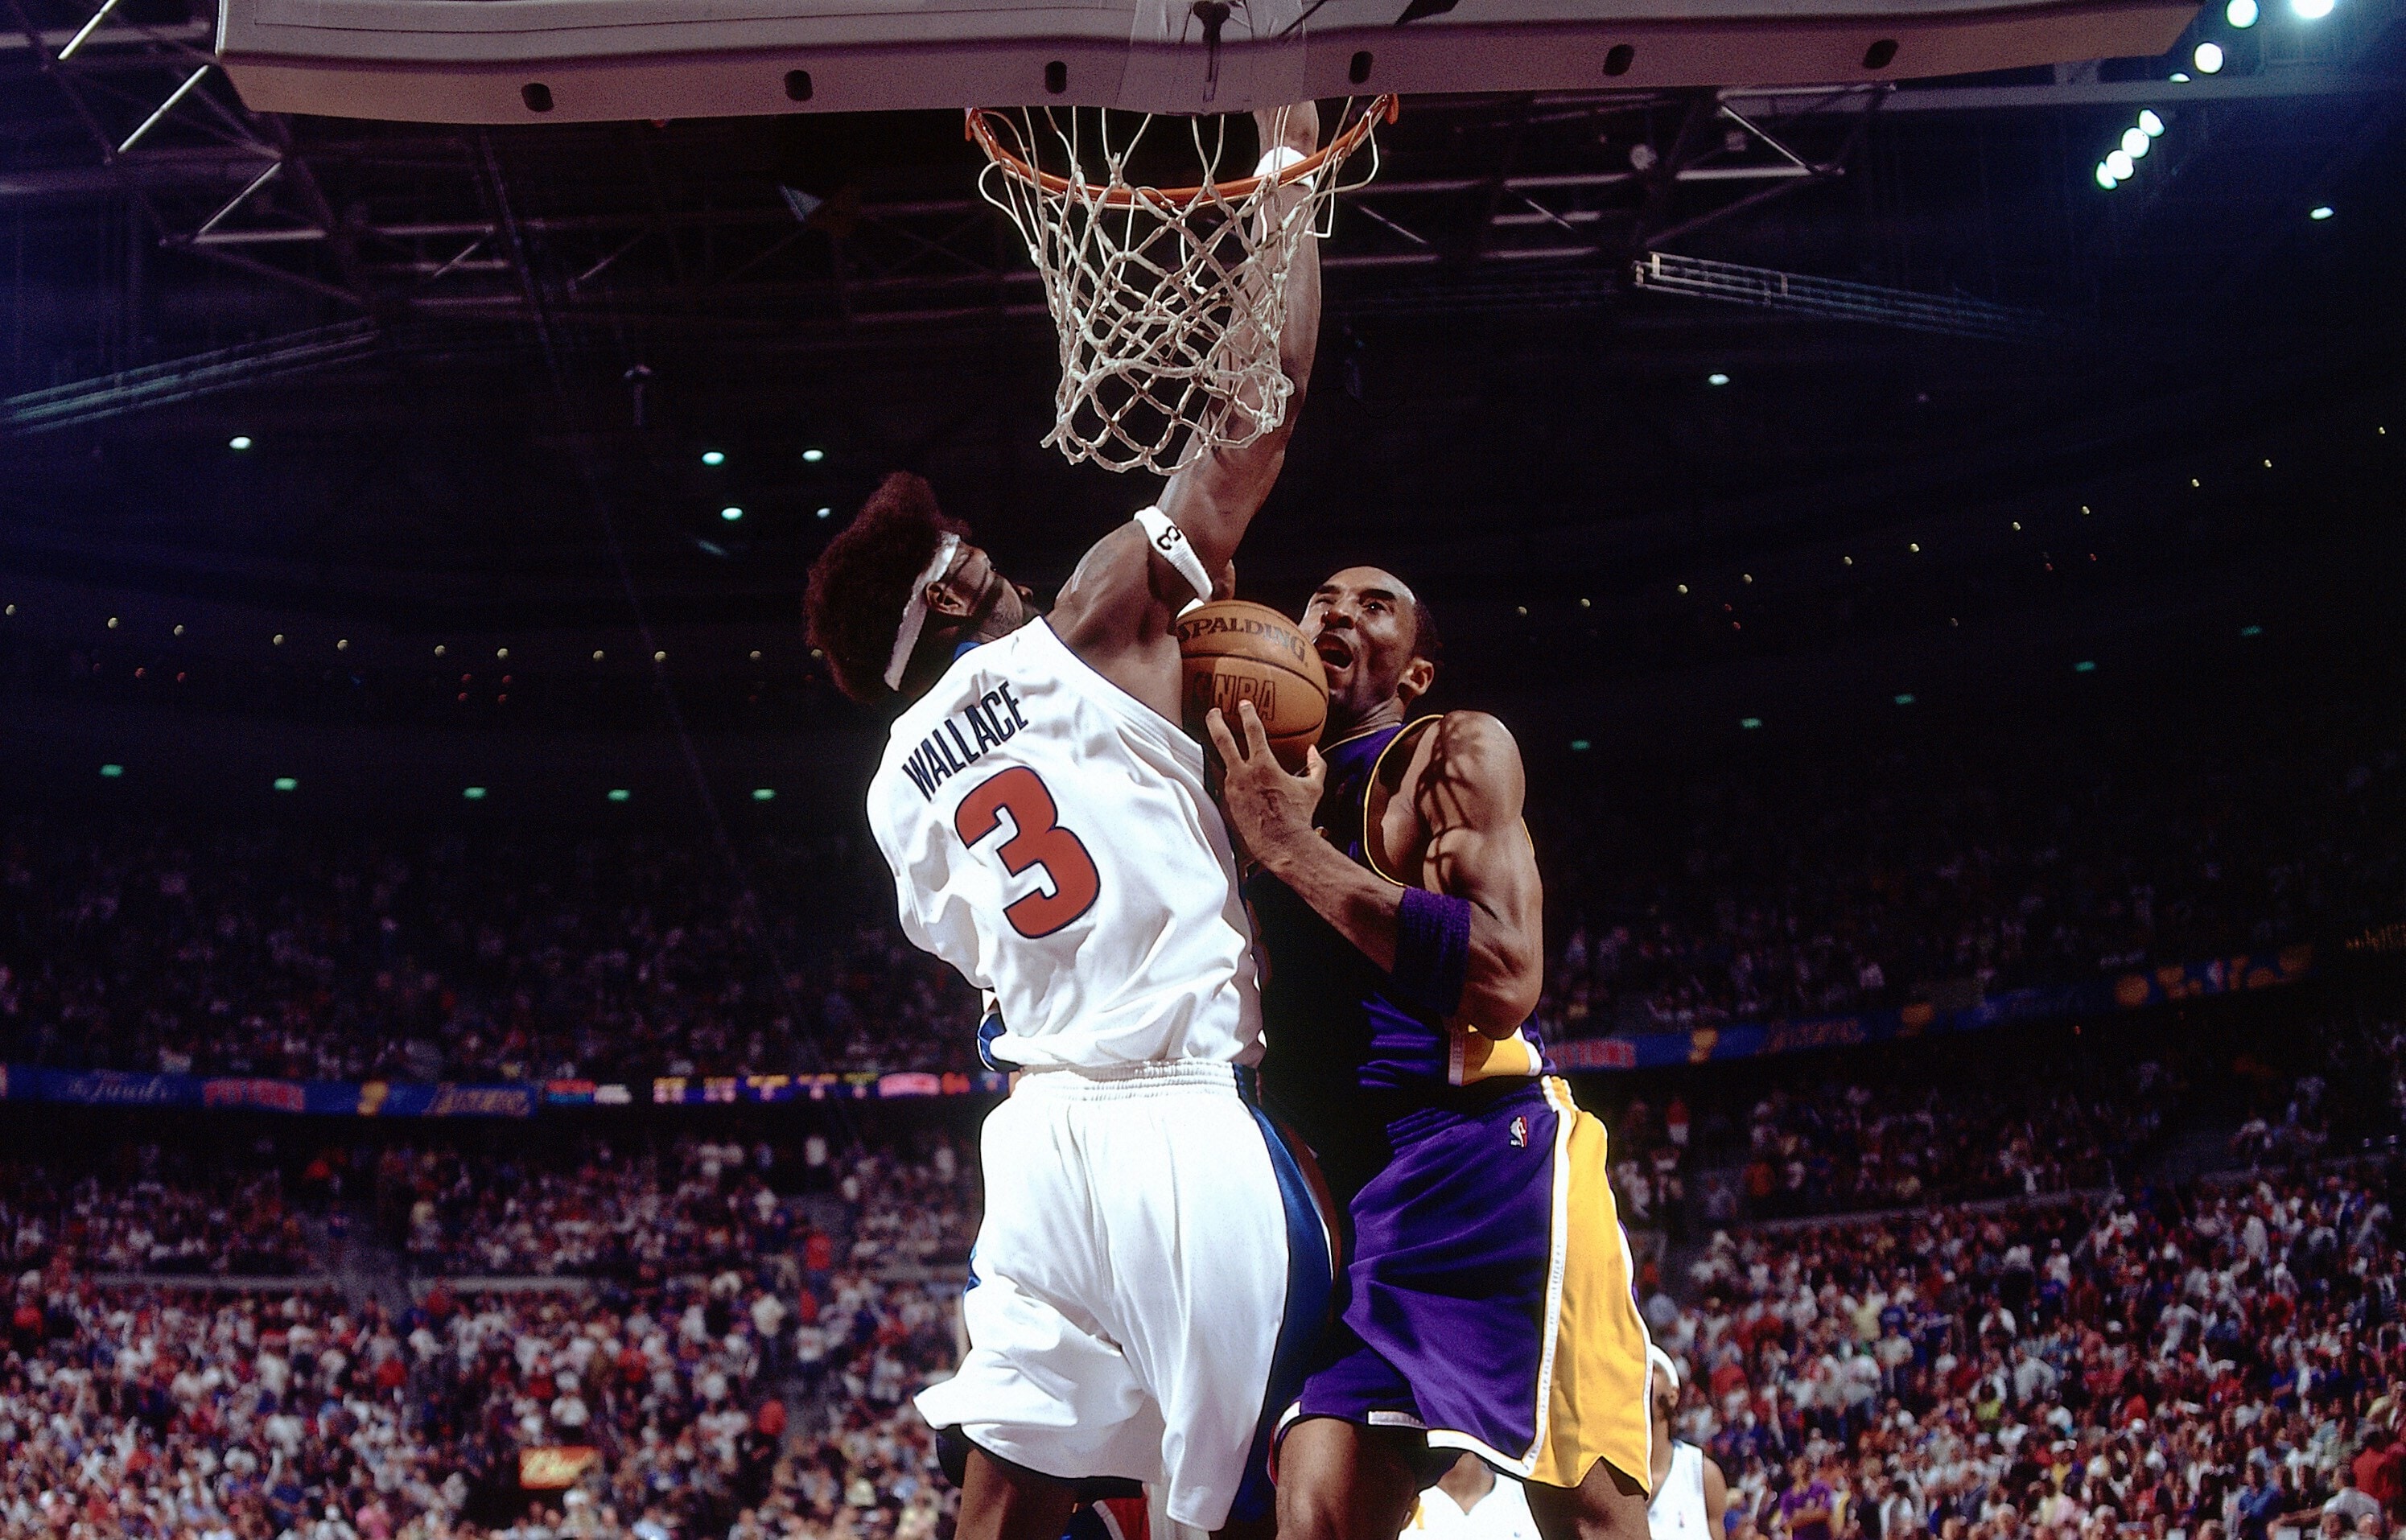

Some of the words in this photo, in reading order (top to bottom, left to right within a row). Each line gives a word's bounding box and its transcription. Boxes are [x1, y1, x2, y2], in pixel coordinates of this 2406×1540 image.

[1156, 525, 1181, 550] 3
[1177, 617, 1306, 662] SPALDING
[1214, 673, 1275, 721] NBA
[902, 681, 1029, 803] WALLACE
[954, 765, 1101, 939] 3
